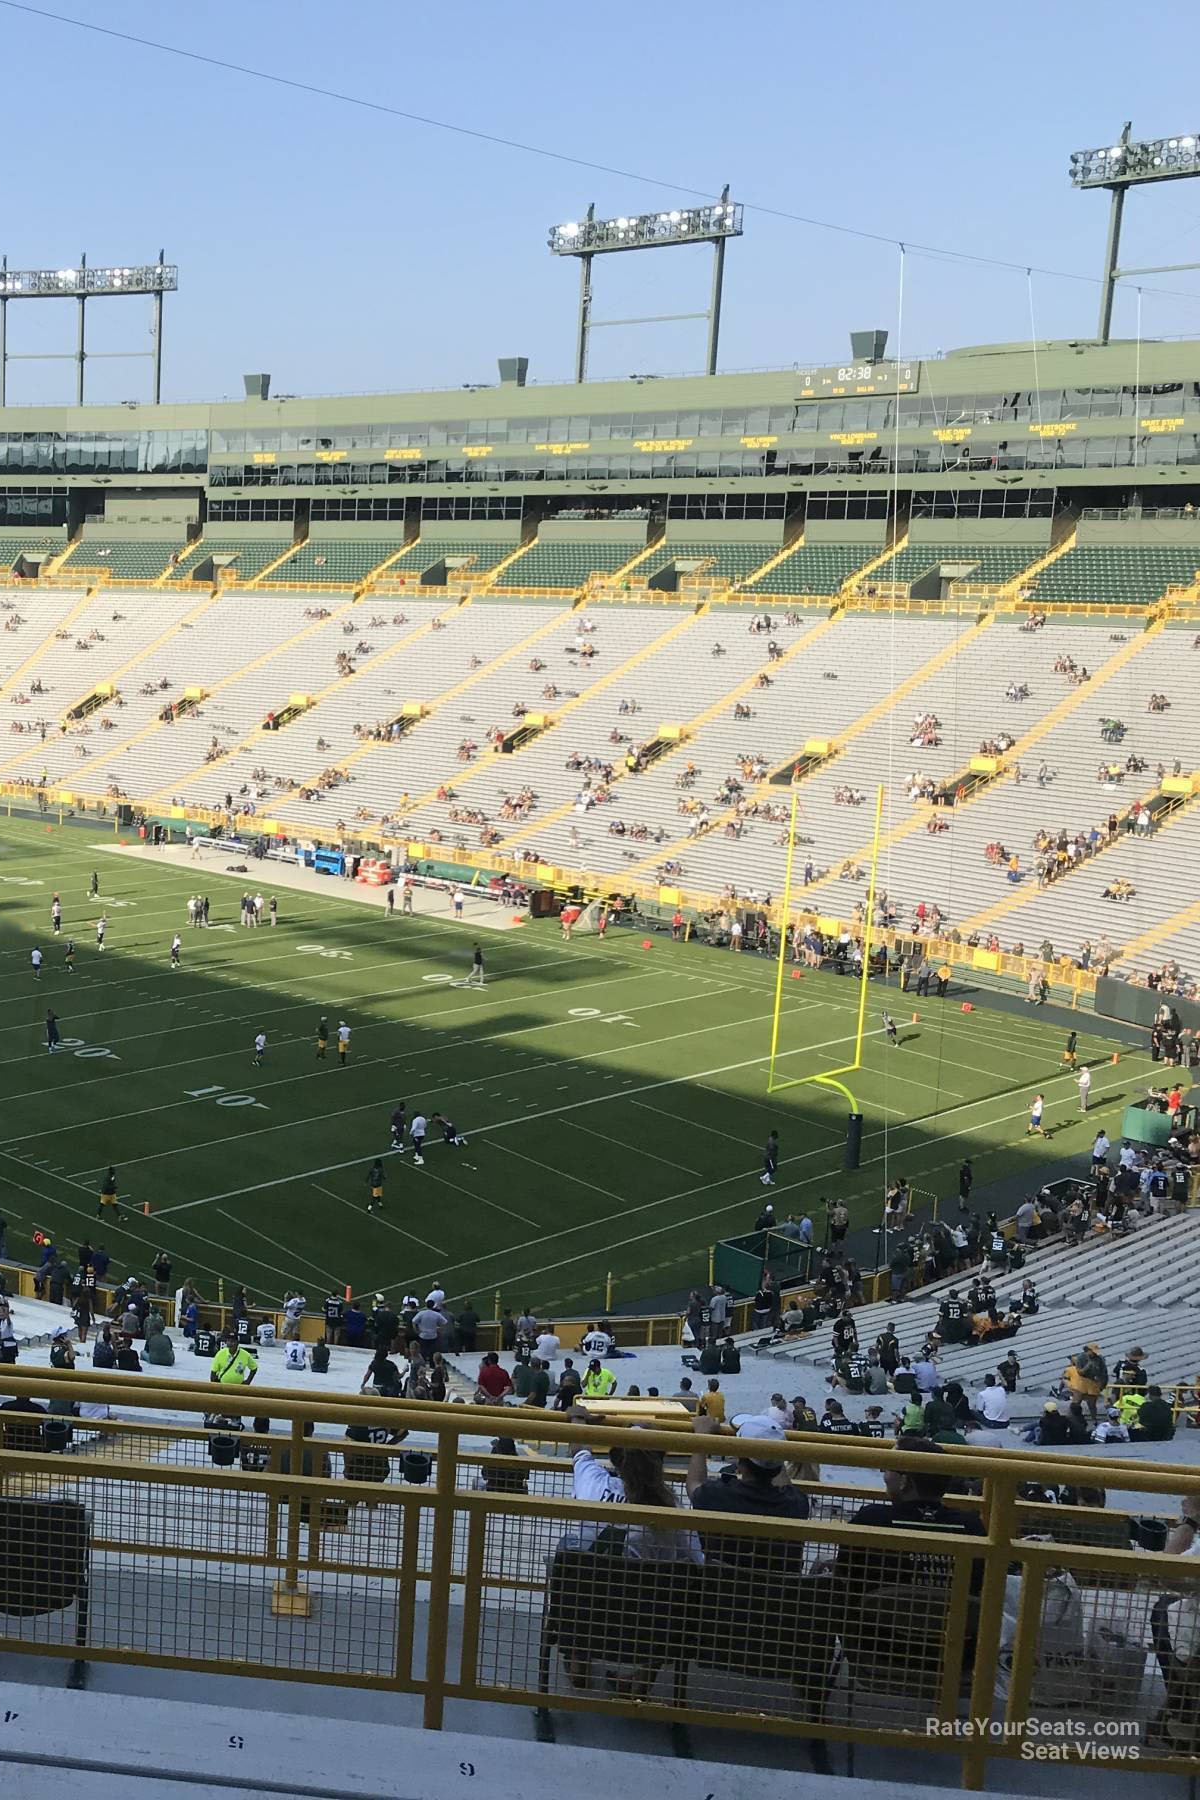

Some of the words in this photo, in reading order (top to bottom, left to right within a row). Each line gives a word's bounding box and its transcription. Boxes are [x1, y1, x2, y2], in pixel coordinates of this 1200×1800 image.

[838, 366, 872, 381] 82:38
[184, 1085, 258, 1108] 10
[85, 1278, 95, 1288] 12
[328, 1306, 339, 1319] 21
[948, 1308, 961, 1319] 12
[238, 1324, 248, 1334] 12
[264, 1330, 274, 1339] 52
[843, 1328, 855, 1340] 84
[198, 1340, 209, 1351] 12
[592, 1340, 604, 1352] 12
[290, 1348, 298, 1362] 4
[850, 1364, 861, 1378] 21
[368, 1430, 388, 1444] 12
[4, 1710, 19, 1723] 4
